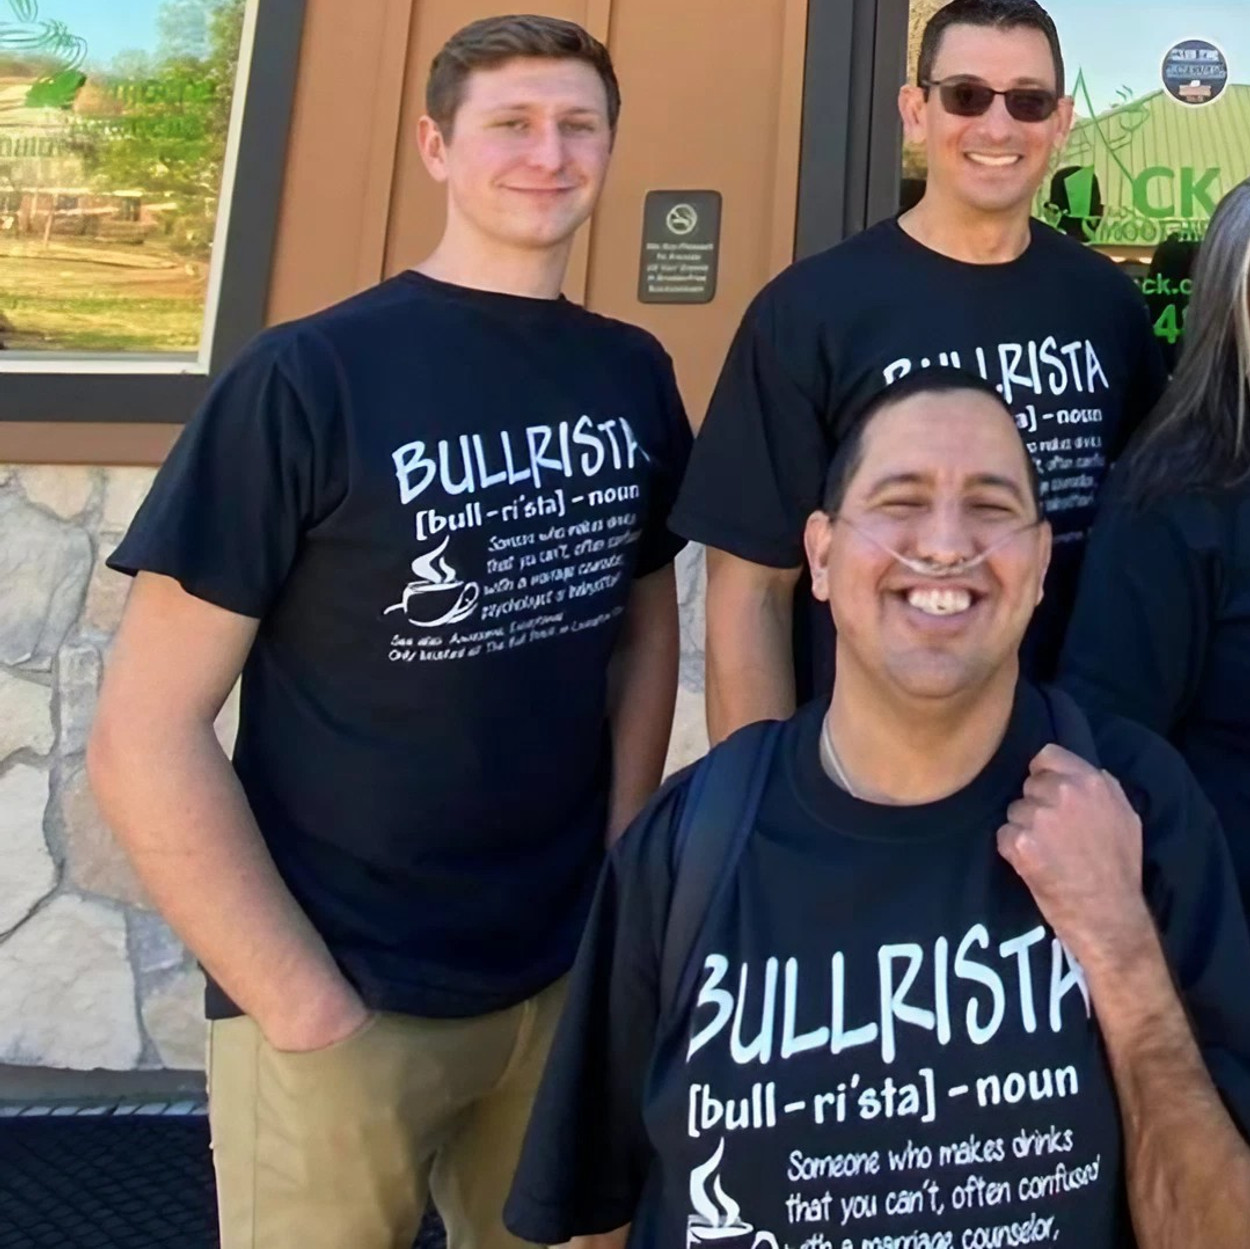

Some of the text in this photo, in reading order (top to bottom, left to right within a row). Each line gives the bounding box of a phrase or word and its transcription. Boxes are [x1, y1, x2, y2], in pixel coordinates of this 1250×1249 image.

[392, 414, 650, 505] BULLRISTA
[686, 922, 1091, 1065] BULLRISTA
[787, 1124, 1074, 1182] Someone who makes drinks
[785, 1190, 833, 1225] that
[840, 1193, 878, 1227] you
[951, 1174, 1012, 1210] often
